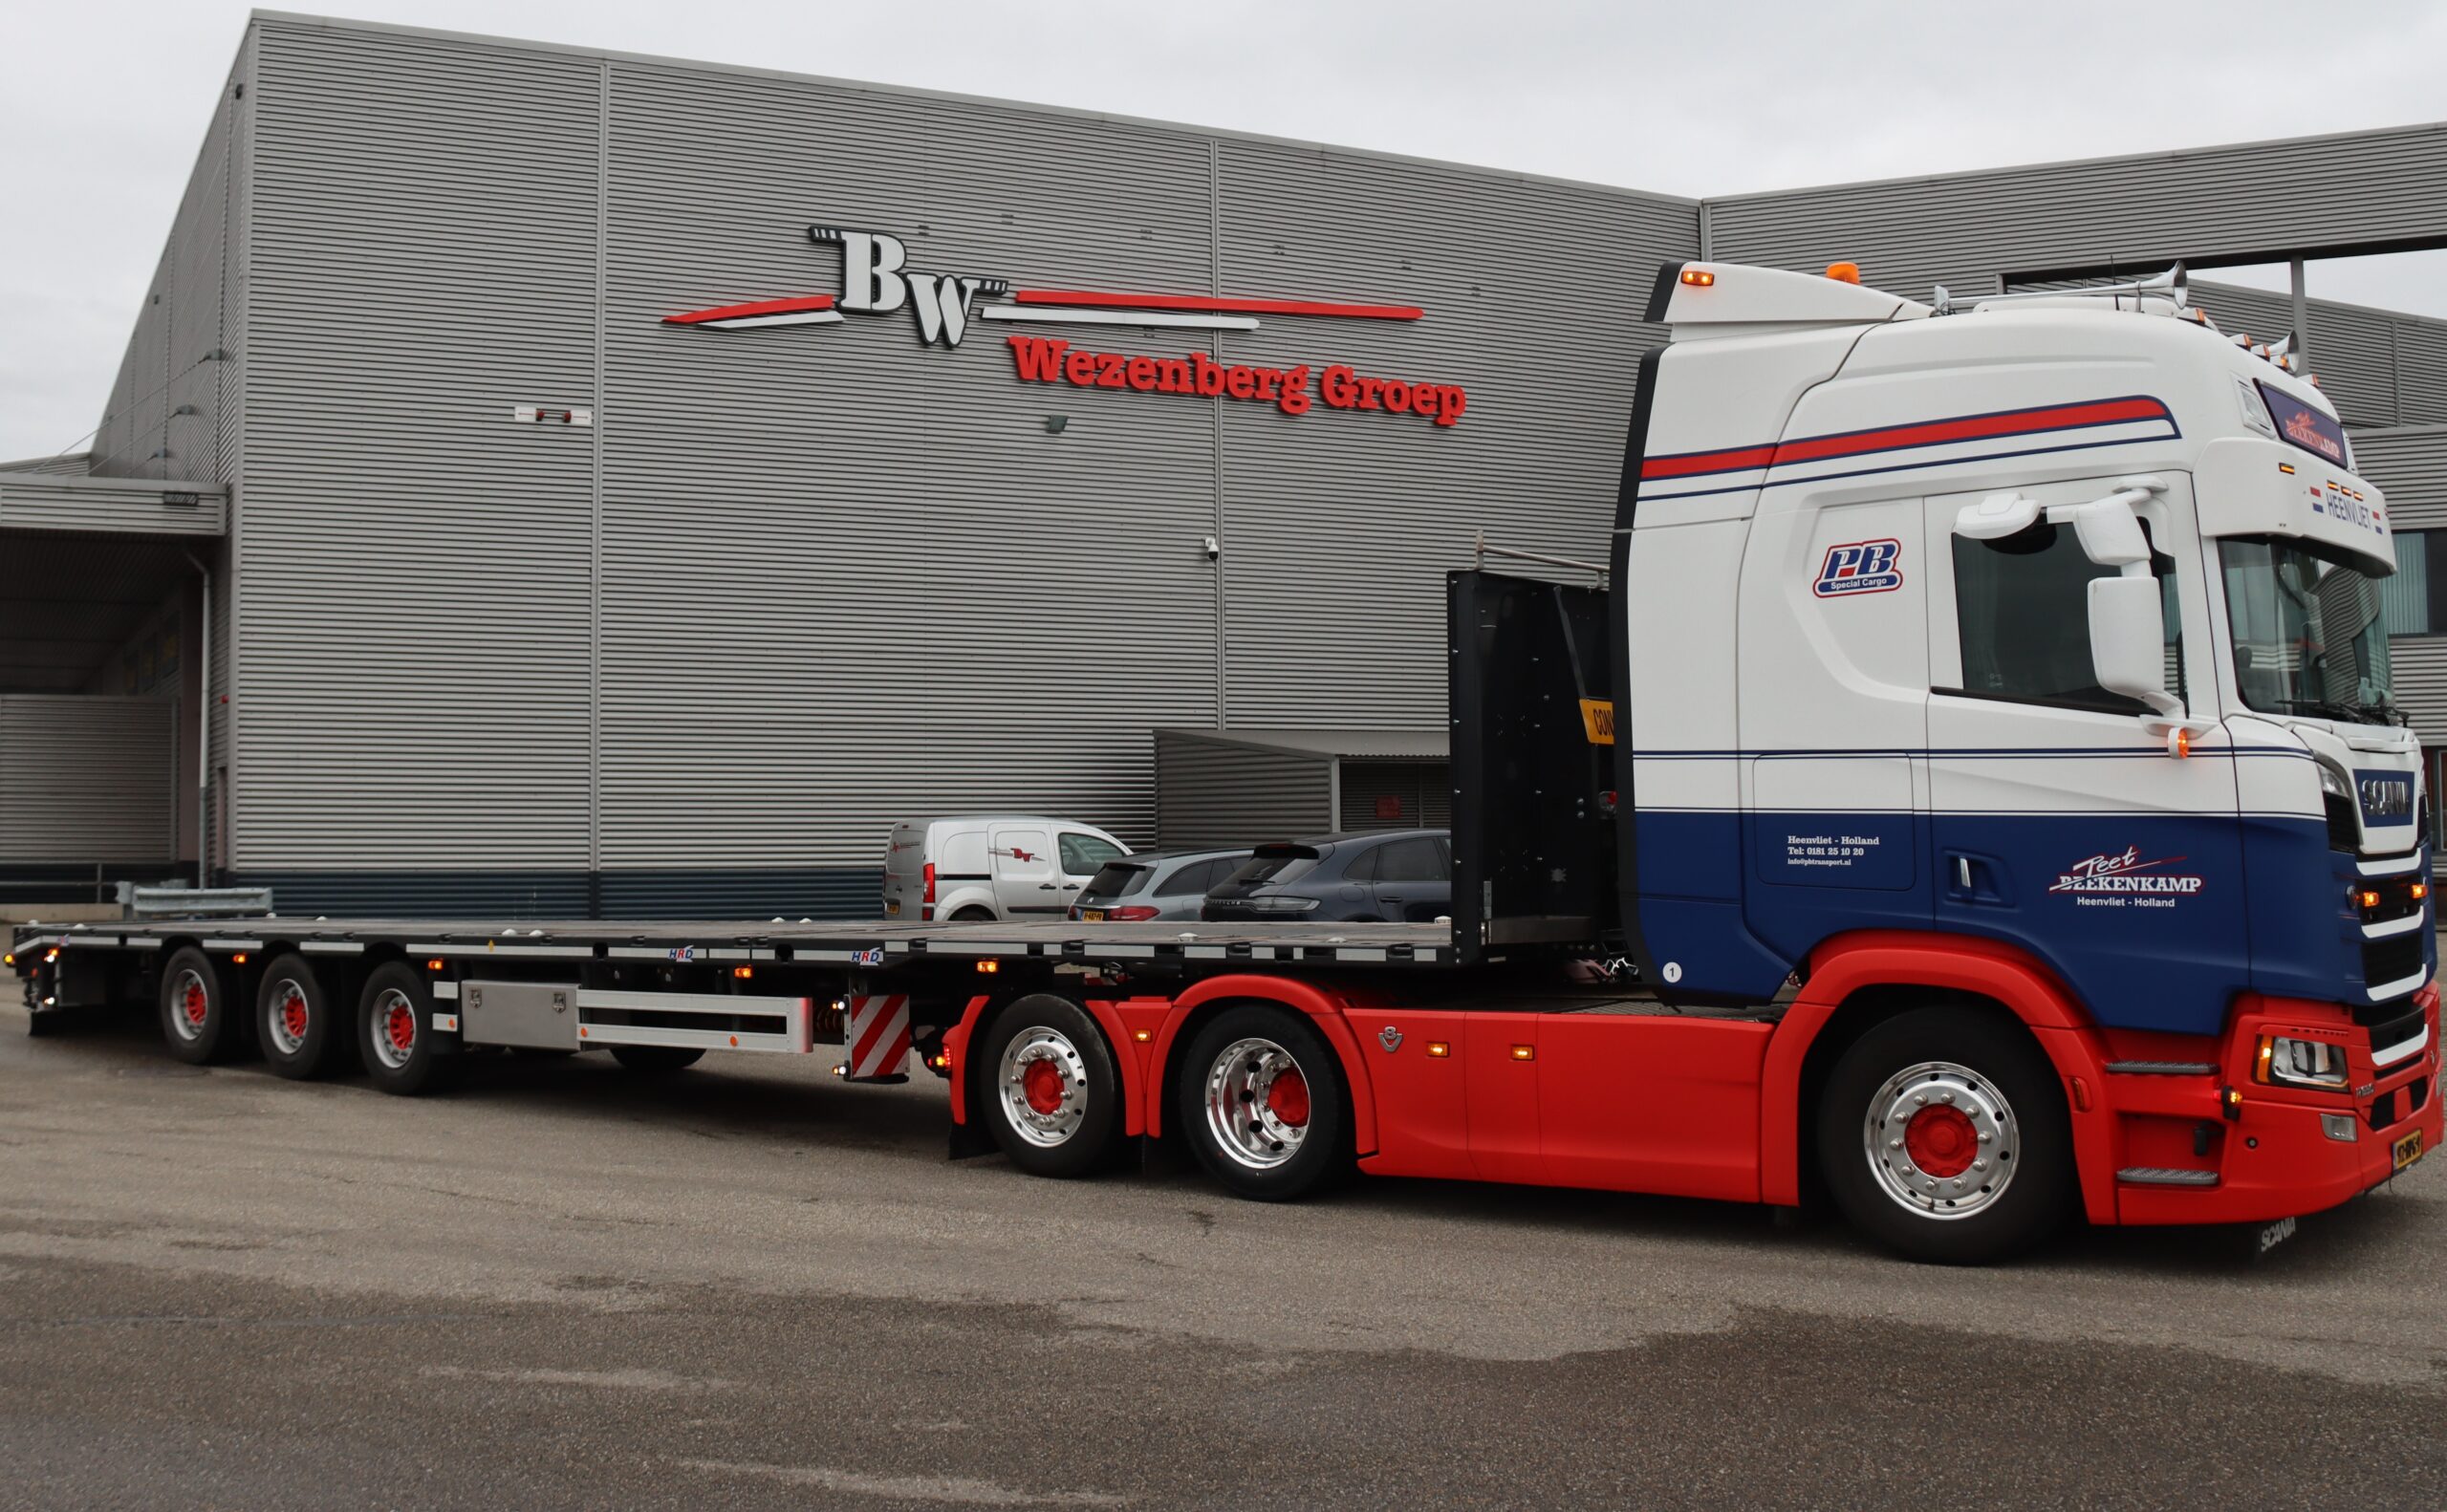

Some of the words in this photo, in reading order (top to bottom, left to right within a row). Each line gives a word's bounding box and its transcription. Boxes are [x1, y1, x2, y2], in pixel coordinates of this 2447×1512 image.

[810, 226, 1008, 348] BW
[1007, 335, 1311, 415] Wezenberg
[1320, 364, 1467, 426] Groep
[2326, 491, 2371, 529] HEENVLIET
[1824, 543, 1896, 579] PB
[1830, 580, 1860, 591] Special
[1862, 577, 1887, 587] Cargo
[1593, 708, 1614, 735] CON
[1787, 835, 1832, 845] Heenvliet
[1841, 836, 1879, 845] Holland
[1787, 847, 1805, 855] Tel:
[1807, 847, 1826, 855] 0181
[1828, 847, 1839, 855] 25
[1852, 848, 1864, 856] 20
[2072, 846, 2138, 877] Peet
[2059, 875, 2202, 893] BEEKENKAMP
[2077, 896, 2125, 906] Heenvliet
[2134, 897, 2175, 907] Holland
[669, 947, 694, 960] HRD
[851, 951, 880, 962] HRD
[1669, 966, 1675, 978] 1
